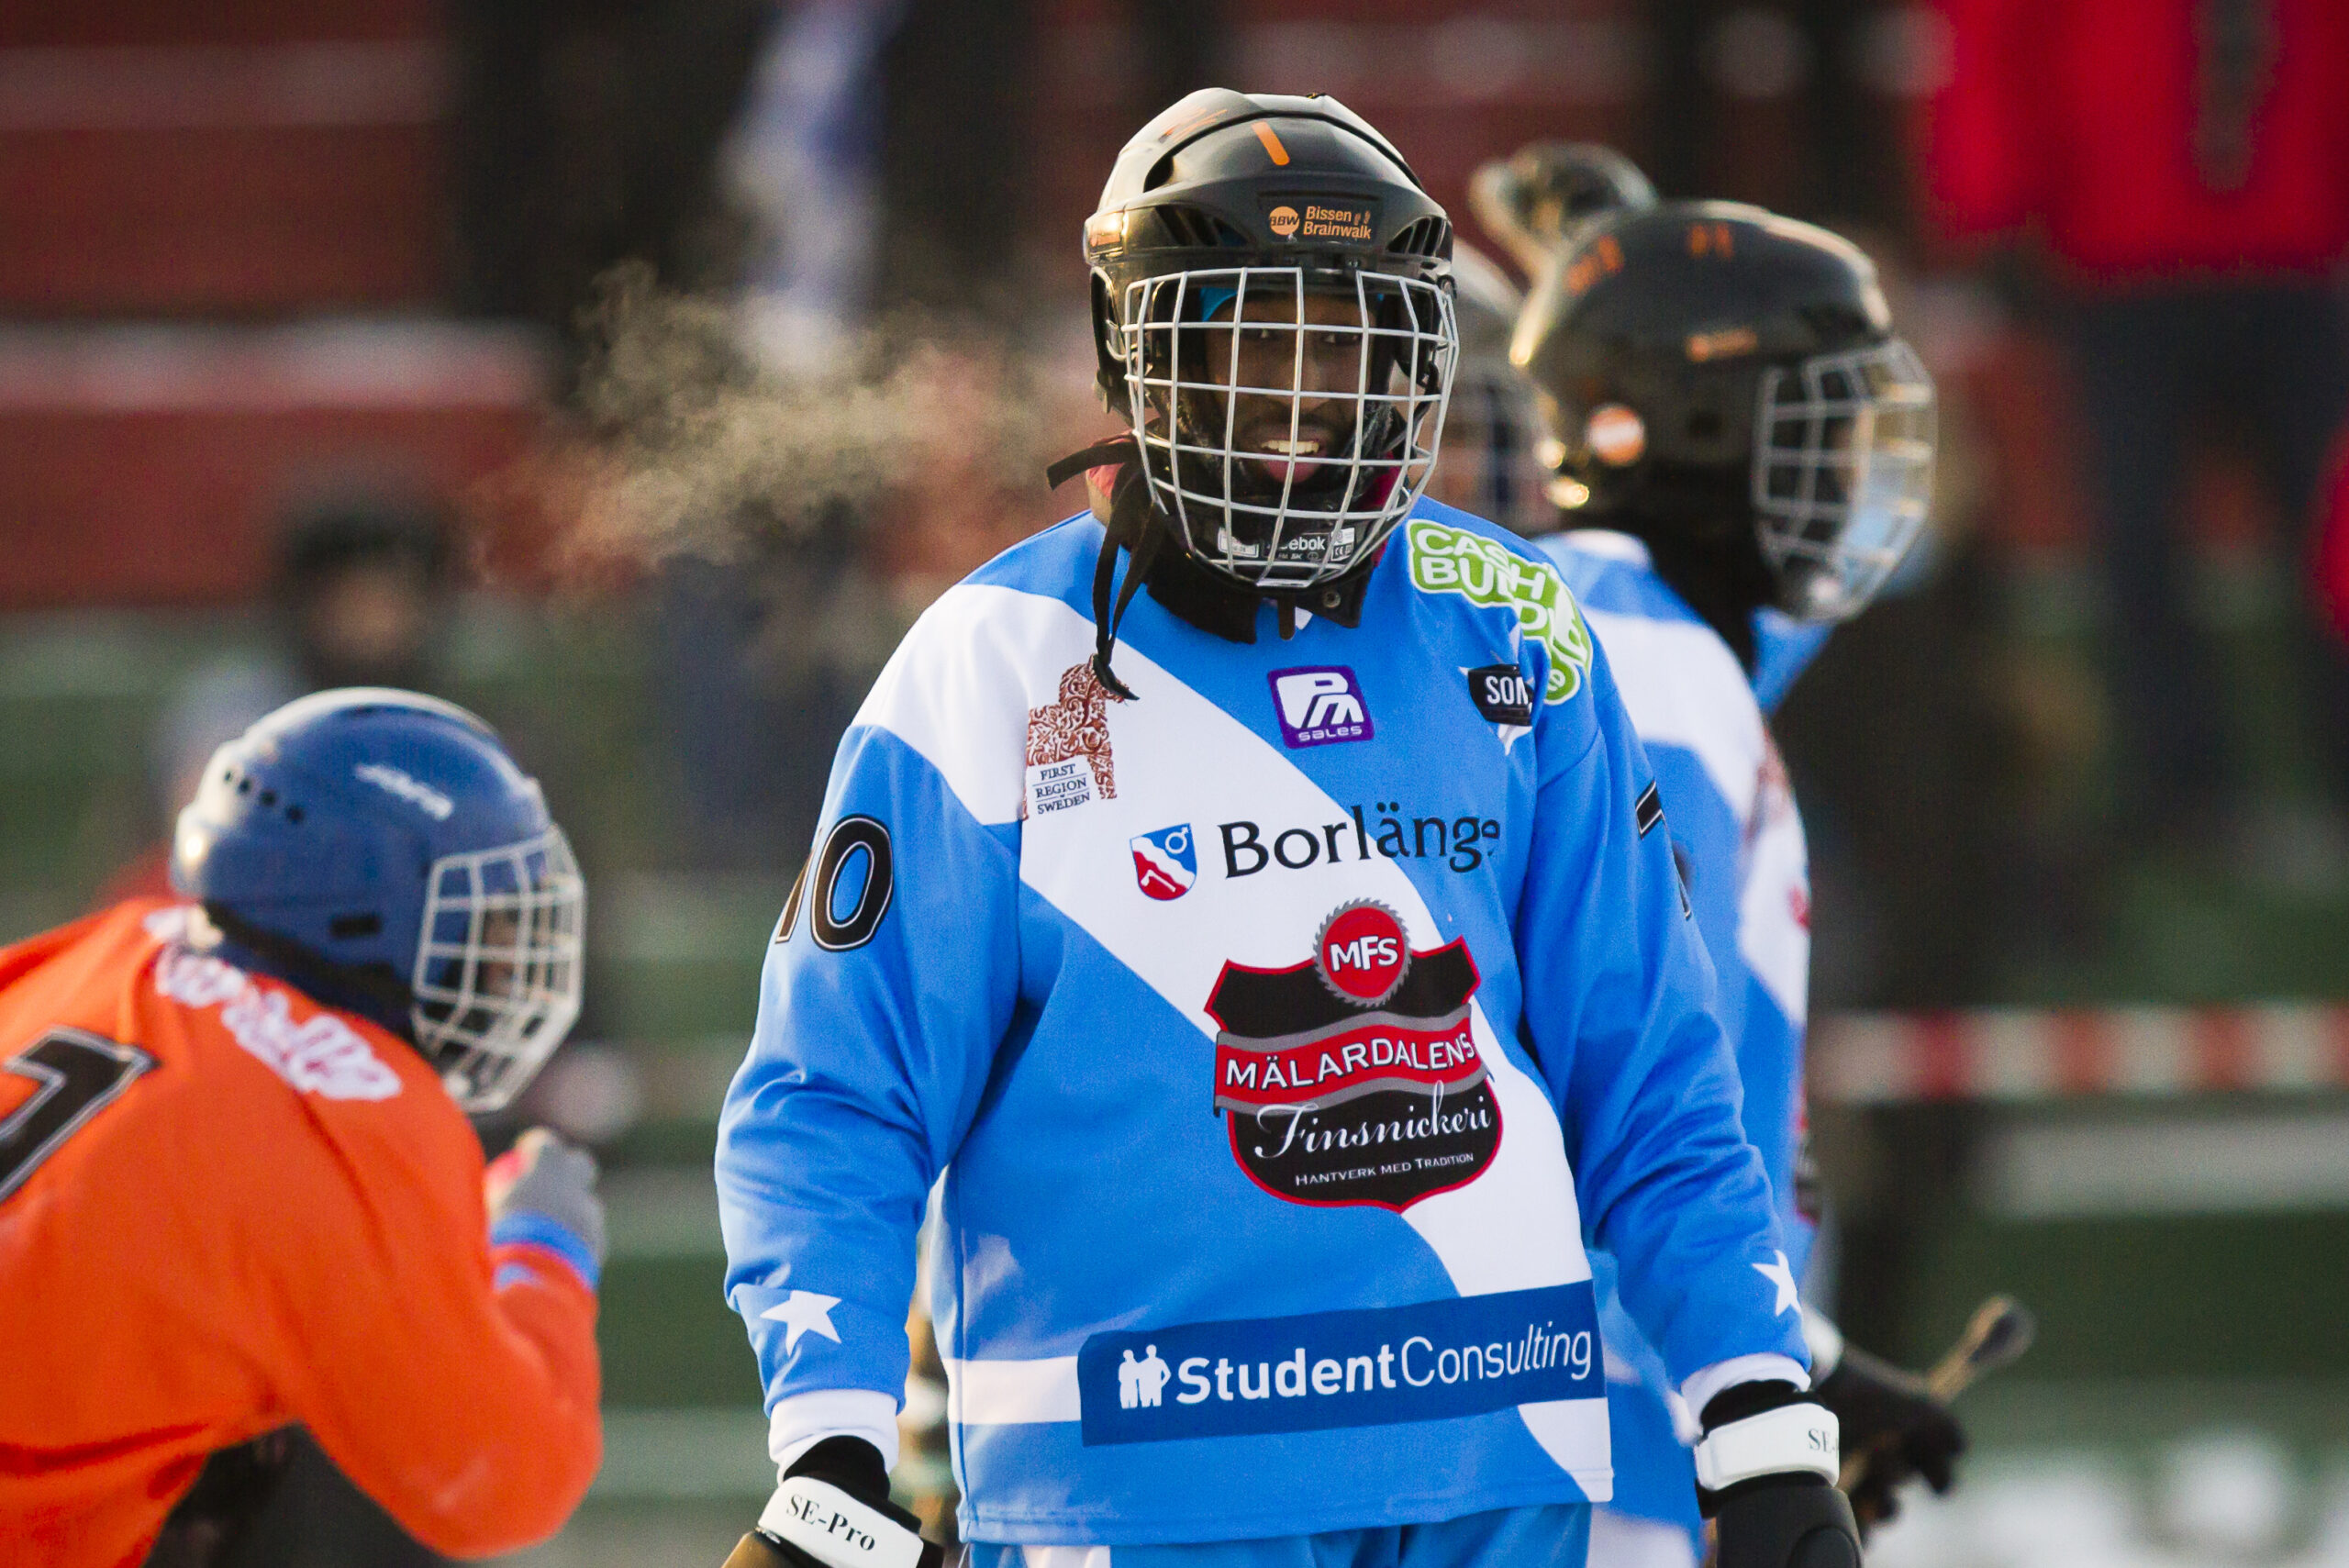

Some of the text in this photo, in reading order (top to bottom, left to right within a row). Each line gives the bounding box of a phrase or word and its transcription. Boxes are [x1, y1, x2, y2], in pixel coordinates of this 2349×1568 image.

[1305, 206, 1353, 222] Bissen
[1303, 221, 1372, 239] Brainwalk
[1416, 528, 1546, 600] CASH
[1298, 726, 1363, 742] sales
[1040, 763, 1076, 781] FIRST
[1035, 777, 1087, 799] REGION
[1037, 792, 1090, 815] SWEDEN
[1330, 935, 1398, 973] MFS
[1224, 1031, 1475, 1091] MÄLARDALENS
[1254, 1080, 1492, 1158] Finsnickeri
[1175, 1320, 1592, 1405] StudentConsulting
[785, 1494, 876, 1551] SE-Pro
